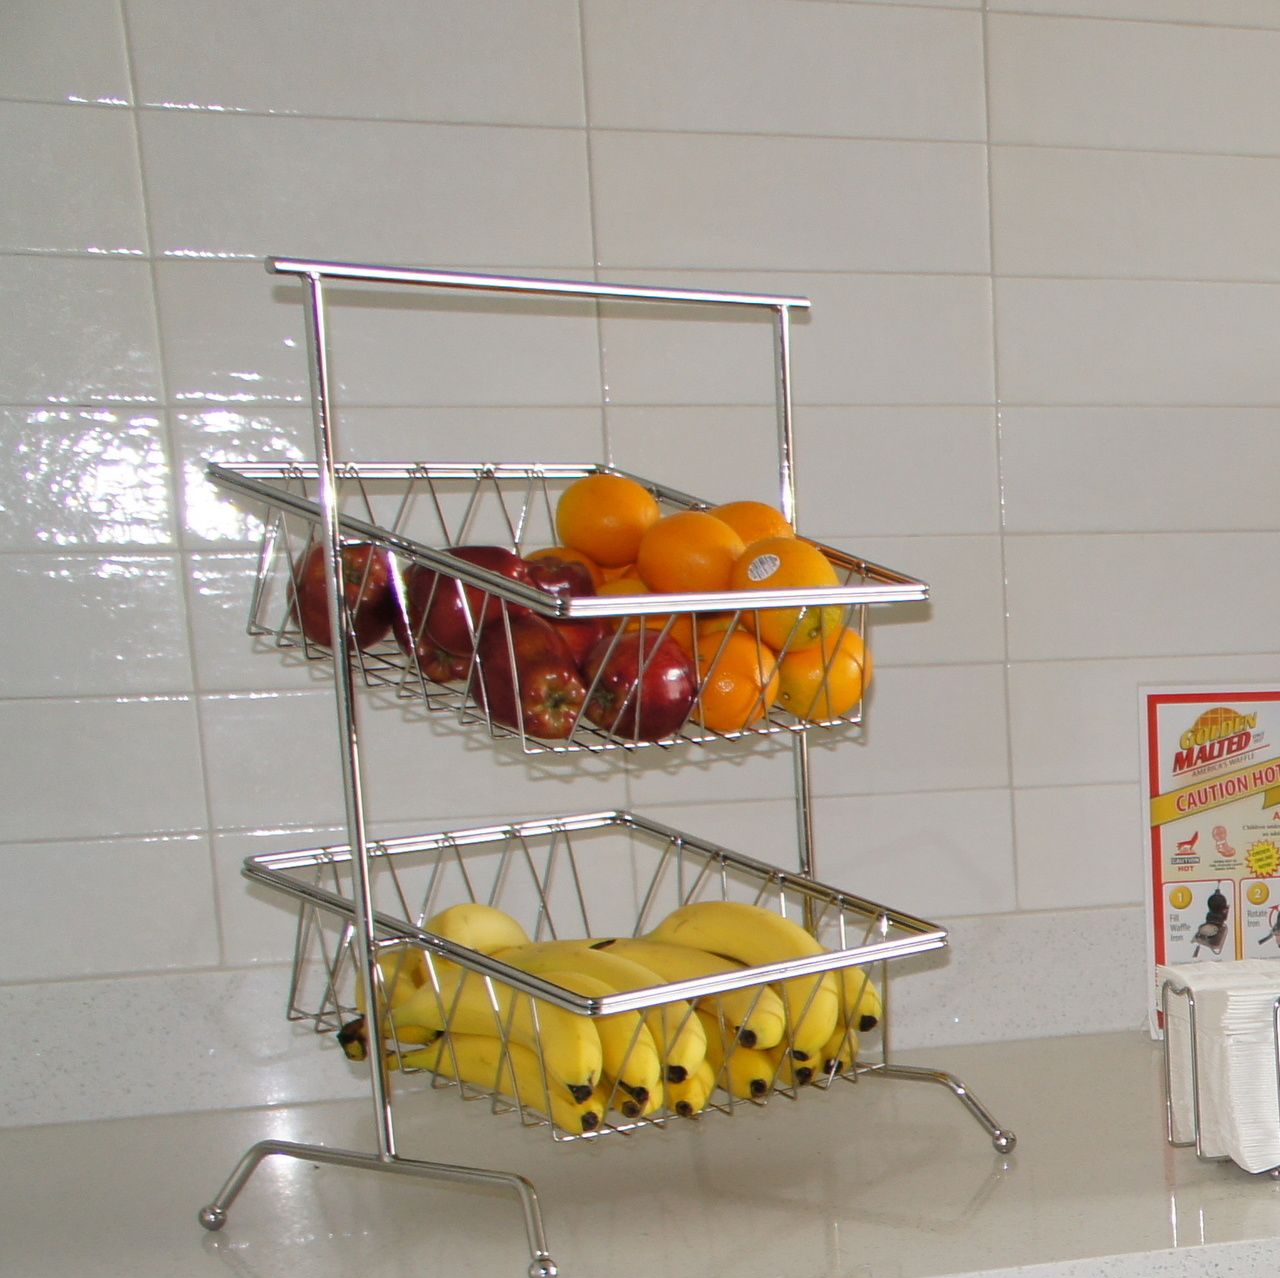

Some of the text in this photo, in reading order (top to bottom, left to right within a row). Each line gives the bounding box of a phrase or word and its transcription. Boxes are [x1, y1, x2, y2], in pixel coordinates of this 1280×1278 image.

[1180, 711, 1257, 750] GOLDEN
[1173, 731, 1252, 772] MALTED
[1176, 774, 1249, 812] CAUTION
[1254, 888, 1263, 898] 2
